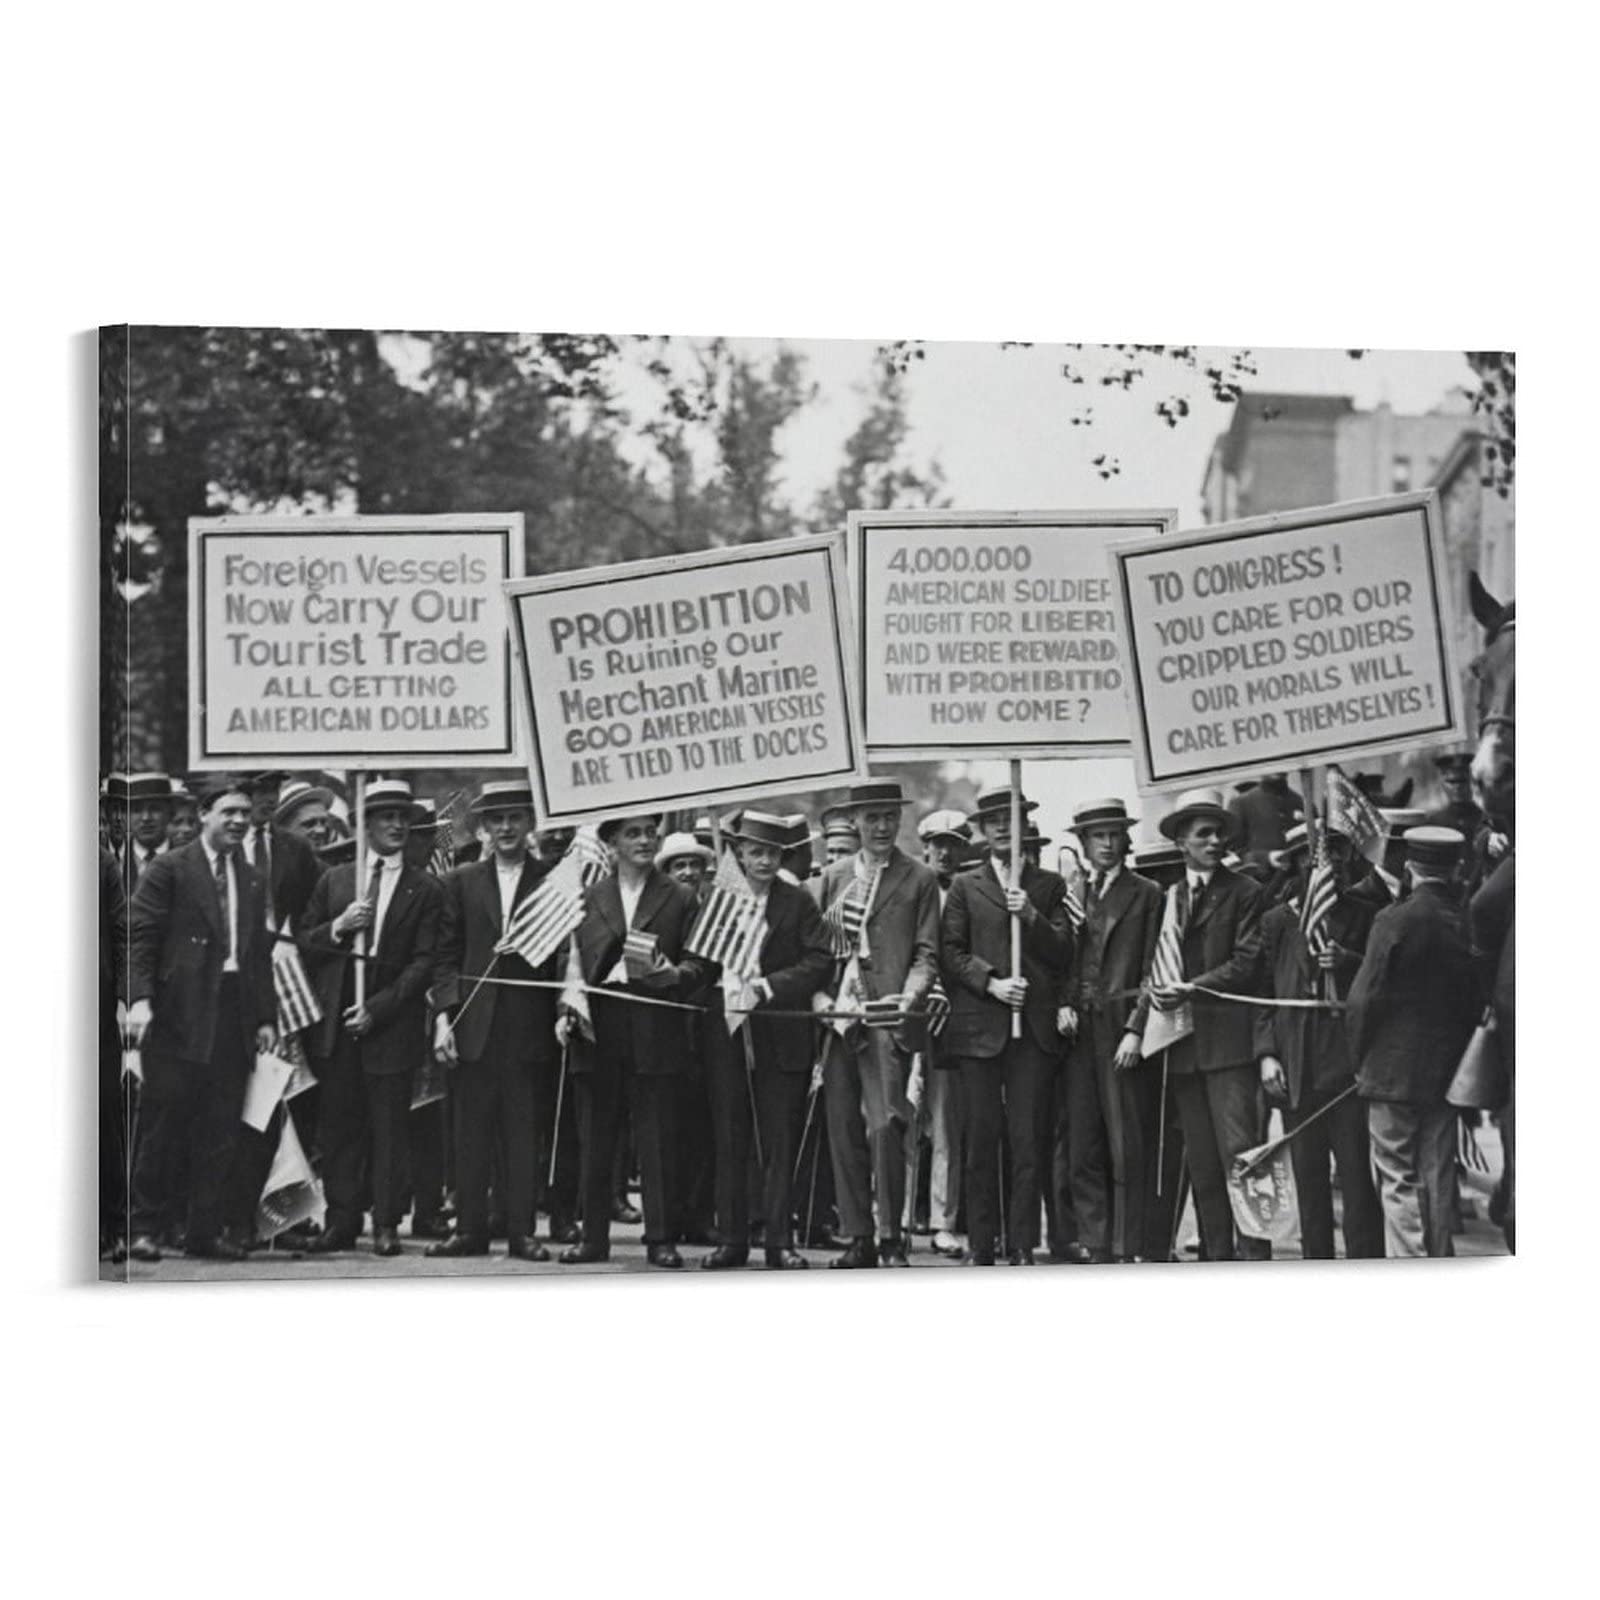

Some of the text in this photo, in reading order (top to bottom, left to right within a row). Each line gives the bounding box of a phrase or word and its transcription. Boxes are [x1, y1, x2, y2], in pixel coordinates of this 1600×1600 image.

[225, 552, 487, 591] Foreign Vessels
[1149, 571, 1184, 605] TO
[225, 589, 487, 630] Now Carry Our
[886, 580, 1005, 605] AMERICAN
[549, 581, 812, 654] PROHIBITION
[884, 612, 964, 634] FOUGHT
[971, 612, 1012, 633] FOR
[1155, 580, 1412, 647] YOU CARE FOR OUR
[226, 631, 487, 666] Tourist Trade
[568, 630, 784, 682] Is Ruining Our
[885, 641, 930, 665] AND
[938, 641, 1003, 664] WERE
[1158, 615, 1414, 683] CRIPPLED SOLDIERS
[263, 675, 457, 698] ALL GETTING
[560, 660, 818, 724] Merchant Marine
[886, 672, 941, 695] WITH
[1191, 655, 1413, 714] OUR MORALS WILL
[226, 705, 489, 733] AMERICAN DOLLARS
[565, 693, 825, 753] 600 AMERICAN VESSELS
[931, 702, 986, 724] HOW
[1168, 722, 1228, 755] CARE
[1233, 712, 1278, 744] FOR
[572, 724, 828, 787] ARE TIED TO THE DOCKS
